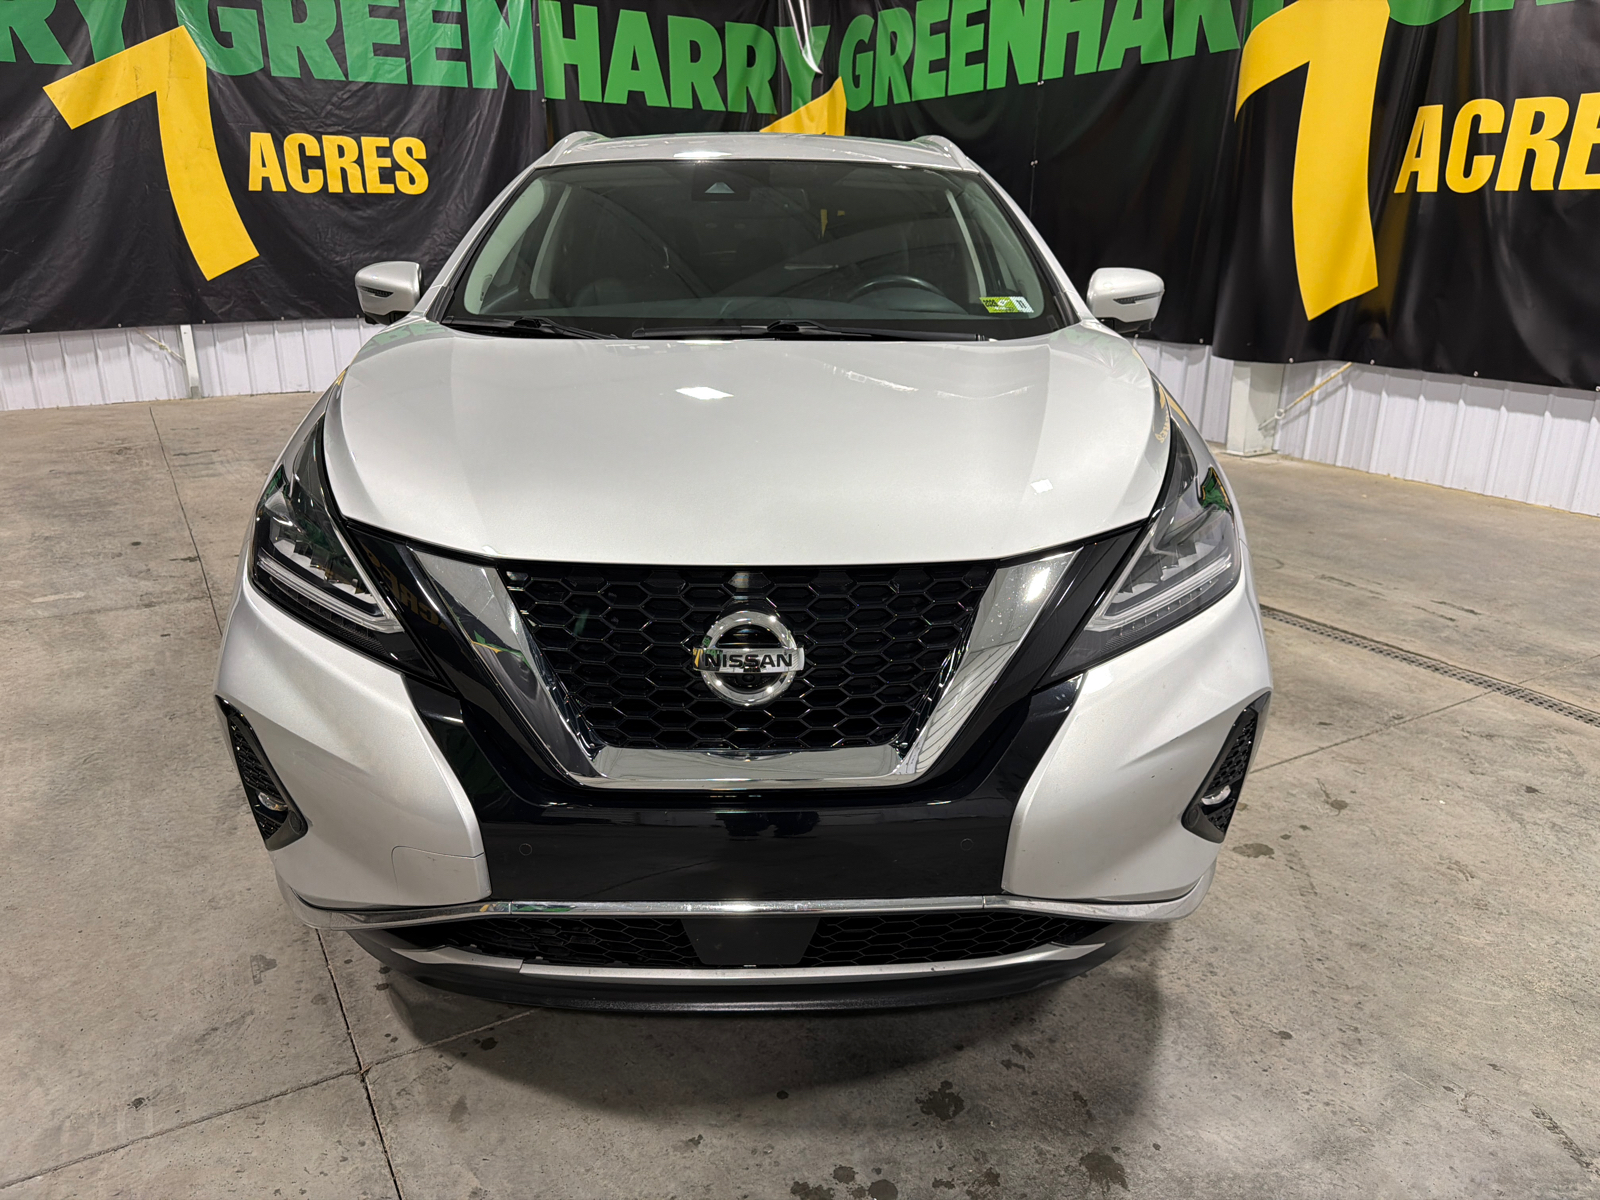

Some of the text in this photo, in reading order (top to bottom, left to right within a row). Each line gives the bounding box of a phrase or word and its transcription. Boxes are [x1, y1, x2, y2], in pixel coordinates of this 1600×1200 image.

[175, 0, 537, 91] GREEN
[540, 0, 831, 114] HARRY
[839, 0, 1045, 112] GREEN
[43, 25, 429, 281] 7 ACRES
[704, 653, 793, 668] NISSAN
